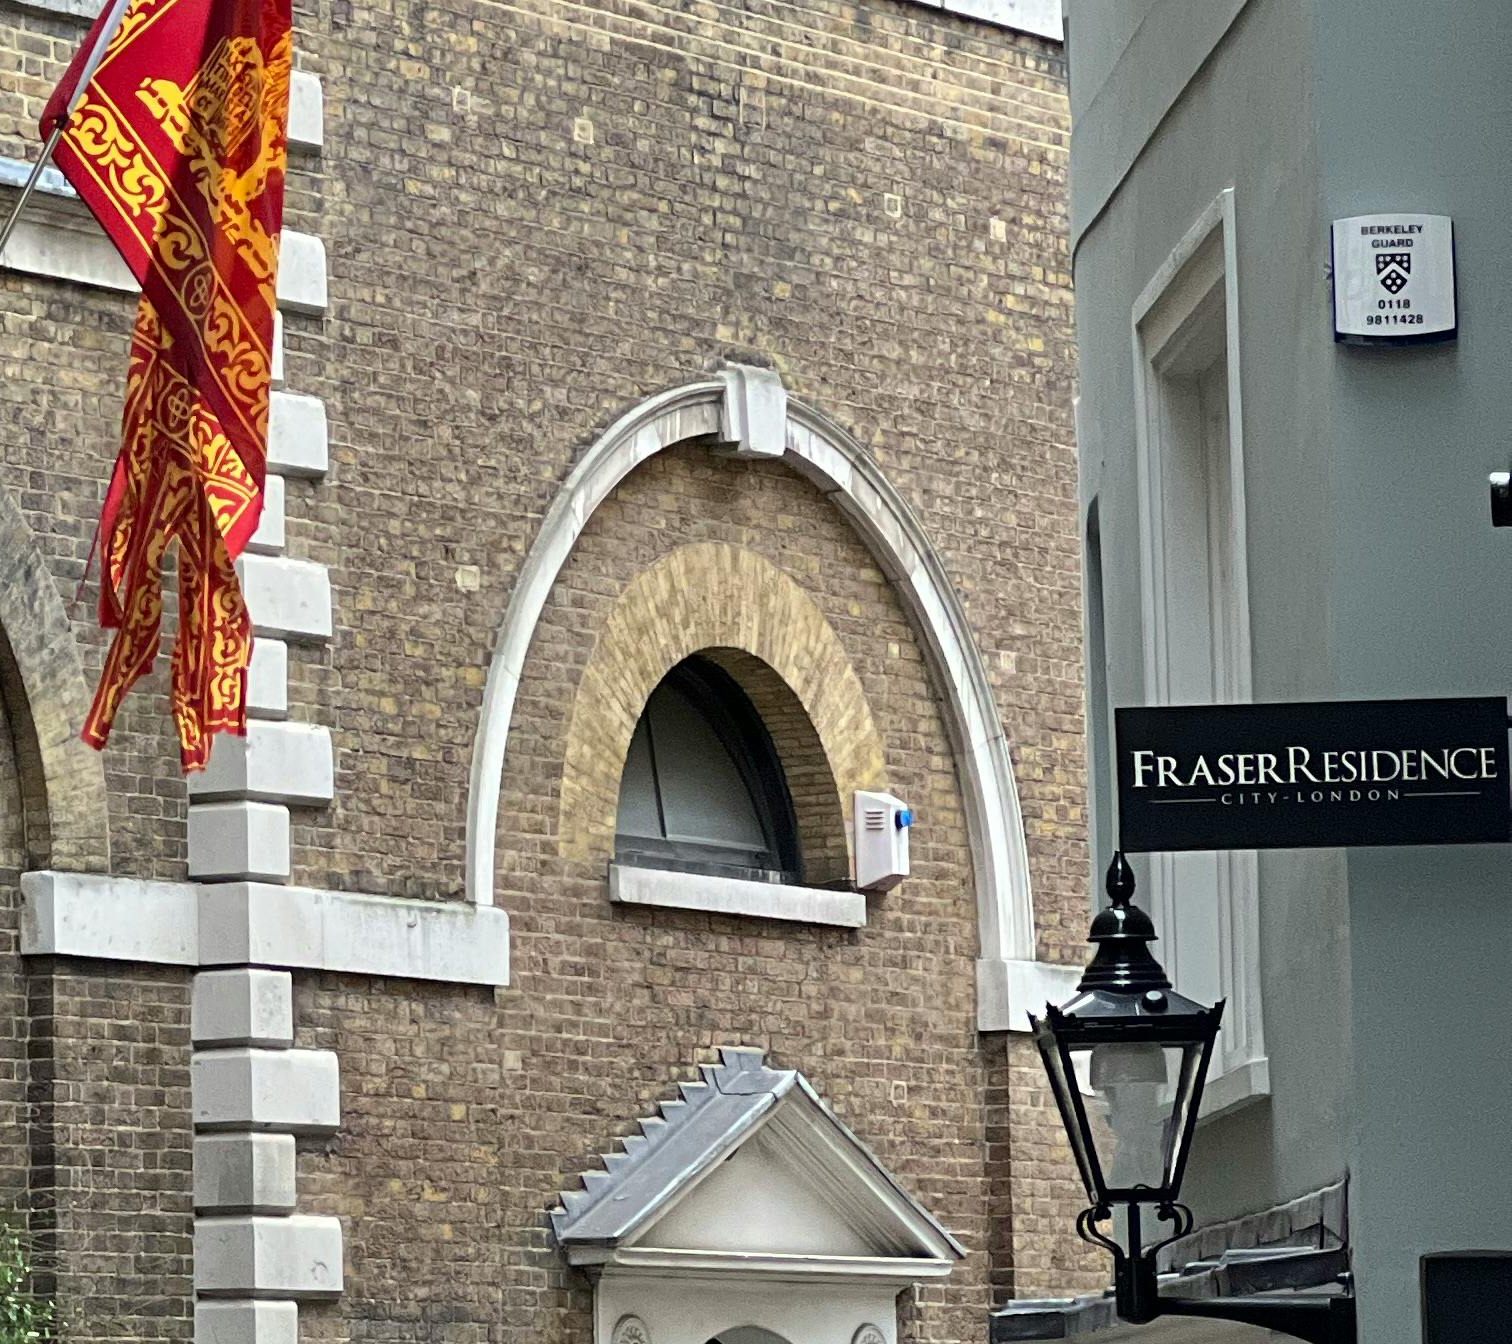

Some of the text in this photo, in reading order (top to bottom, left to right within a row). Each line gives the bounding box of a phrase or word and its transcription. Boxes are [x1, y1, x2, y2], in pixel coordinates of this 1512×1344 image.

[1360, 224, 1424, 236] BERKELEY
[1371, 239, 1414, 249] GUARD
[1378, 299, 1411, 310] 0118
[1366, 313, 1424, 326] 9811428
